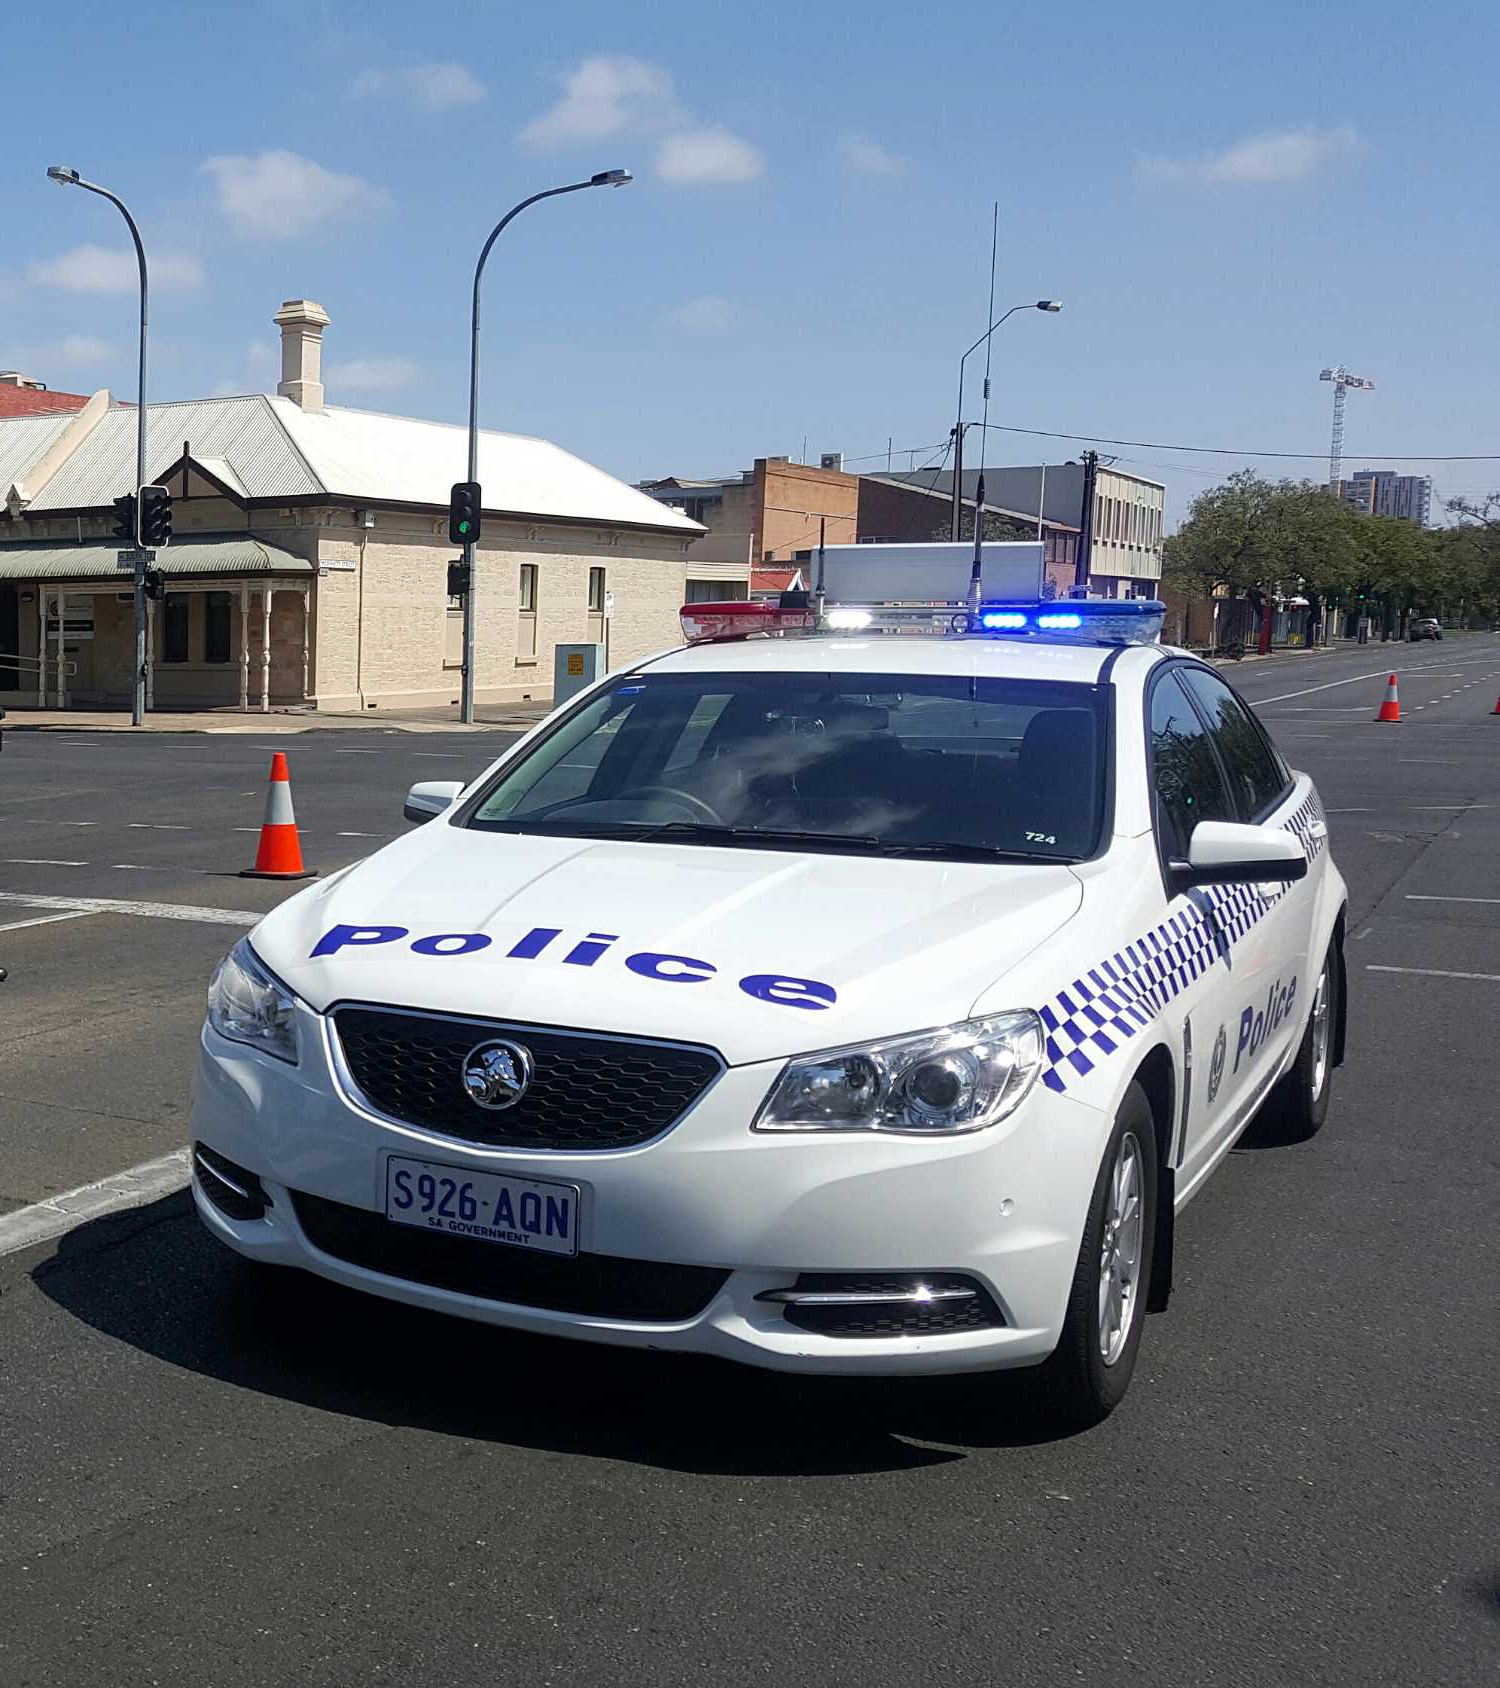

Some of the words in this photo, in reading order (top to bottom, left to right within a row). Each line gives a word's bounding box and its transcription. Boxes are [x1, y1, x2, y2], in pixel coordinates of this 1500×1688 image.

[1025, 831, 1056, 845] 724
[308, 923, 838, 1011] Police
[1232, 975, 1298, 1075] Police
[427, 1216, 444, 1229] SA
[448, 1220, 531, 1245] GOVERNMENT
